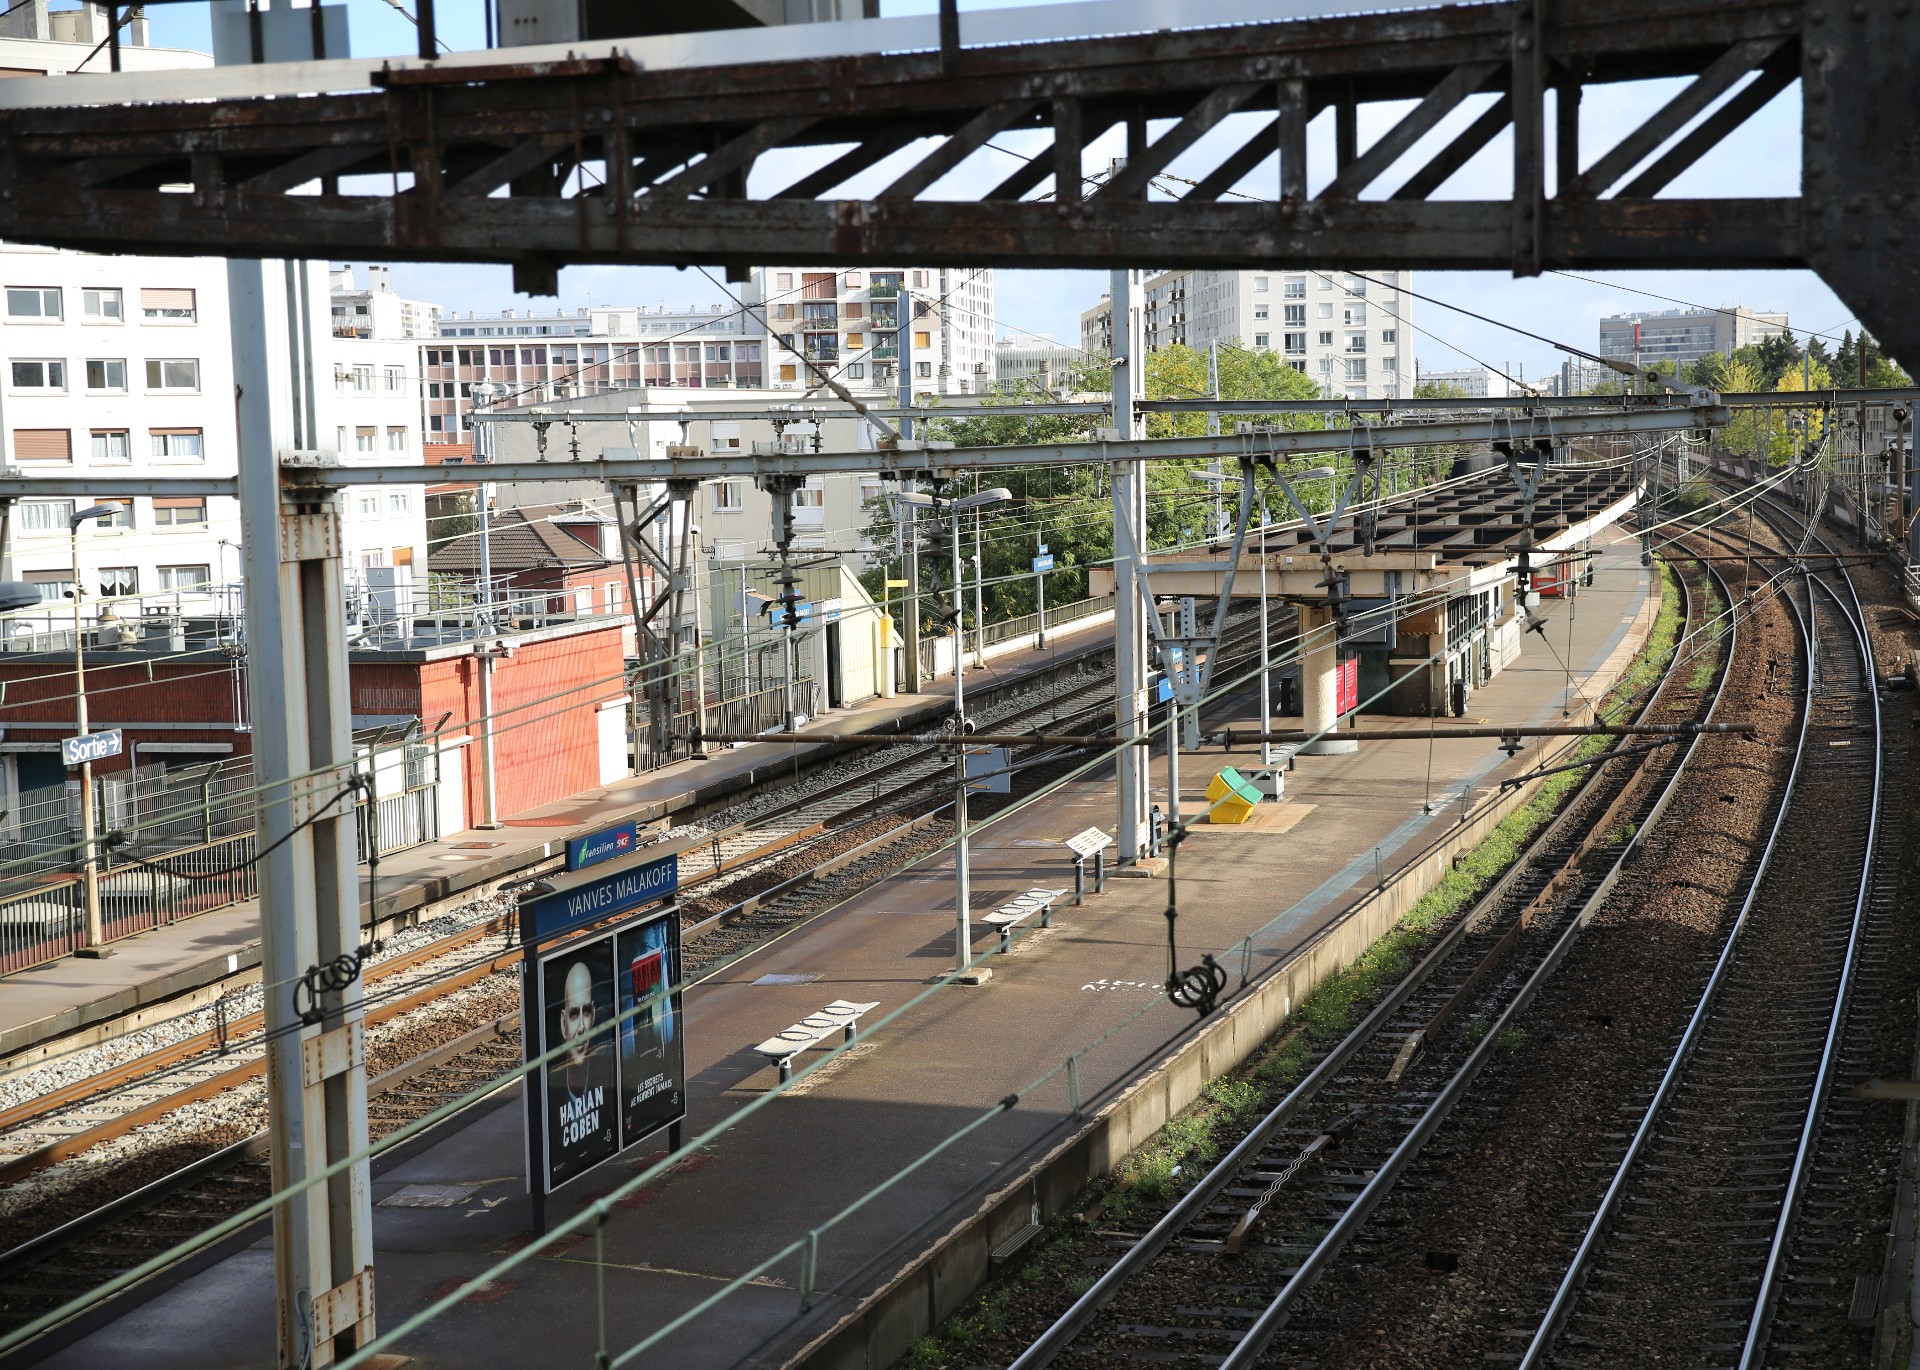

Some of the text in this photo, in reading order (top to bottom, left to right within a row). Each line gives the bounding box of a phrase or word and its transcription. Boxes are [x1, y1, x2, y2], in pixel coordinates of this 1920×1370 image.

[69, 735, 107, 761] Sortie
[580, 840, 614, 860] Transilien
[616, 836, 630, 848] SNCF
[568, 863, 672, 917] VANVES MALAKOFF
[560, 1086, 604, 1127] HARLAN
[563, 1110, 599, 1147] COBEN
